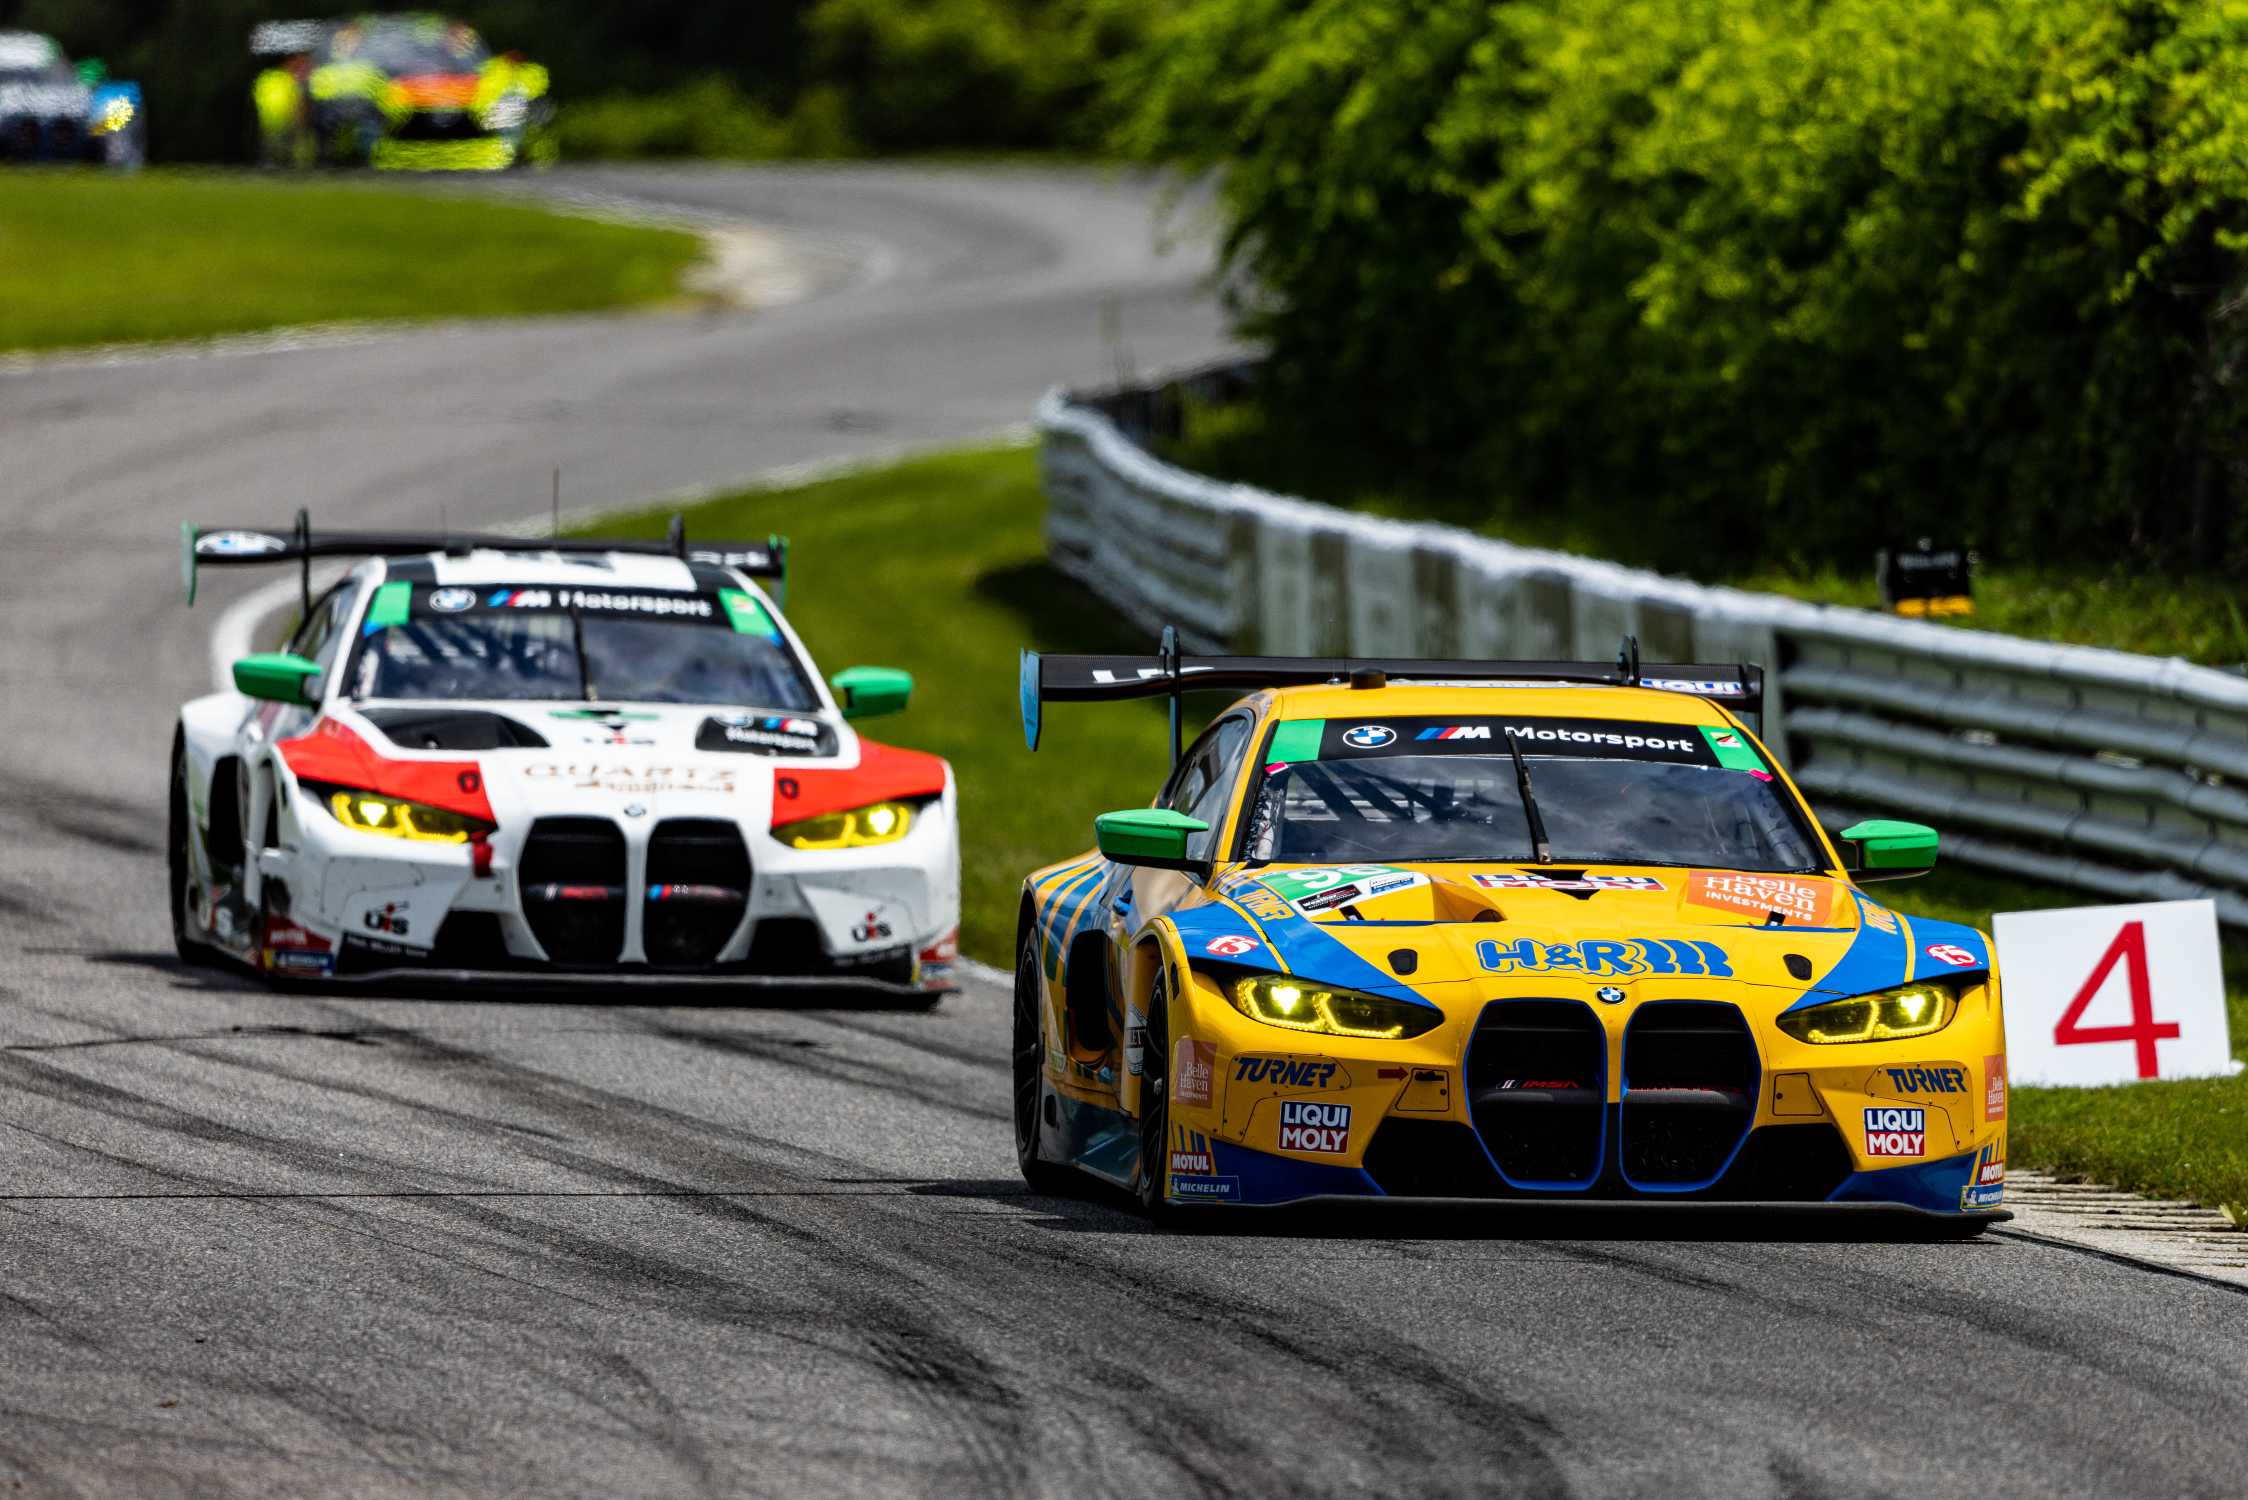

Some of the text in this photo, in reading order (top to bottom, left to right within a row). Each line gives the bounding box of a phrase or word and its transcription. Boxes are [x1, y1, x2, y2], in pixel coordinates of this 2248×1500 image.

[1504, 726, 1694, 753] Motorsport
[1703, 876, 1816, 913] Haven
[1734, 875, 1817, 899] Belle
[1705, 890, 1813, 922] INVESTMENTS
[1475, 937, 1647, 977] H&R
[2054, 921, 2180, 1080] 4
[1235, 1057, 1337, 1088] TURNER
[1886, 1068, 1969, 1093] TURNER
[1283, 1102, 1348, 1128] LIQUI
[1866, 1109, 1923, 1133] LIQUI
[1281, 1127, 1348, 1151] MOLY
[1868, 1132, 1925, 1155] MOLY
[1171, 1153, 1209, 1171] MOTUL
[1179, 1182, 1231, 1194] MICHELIN
